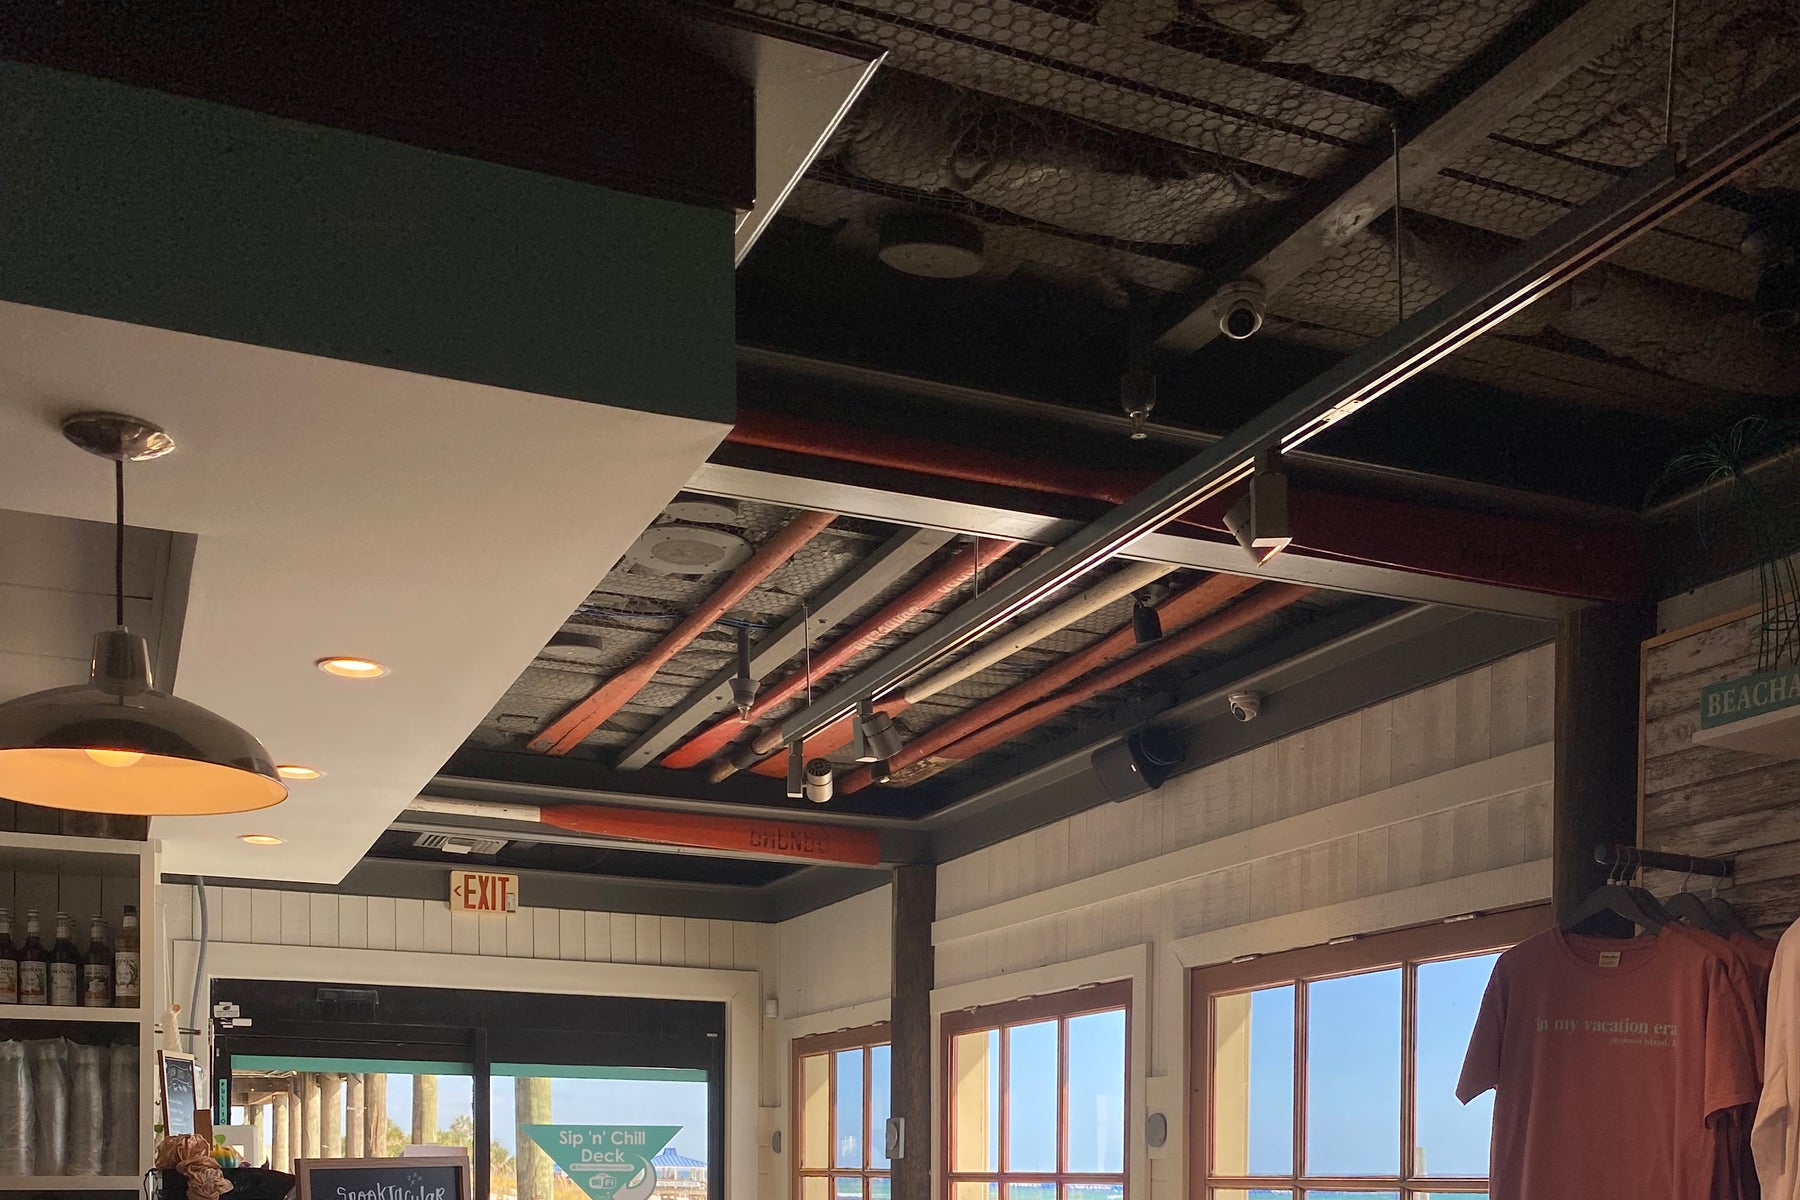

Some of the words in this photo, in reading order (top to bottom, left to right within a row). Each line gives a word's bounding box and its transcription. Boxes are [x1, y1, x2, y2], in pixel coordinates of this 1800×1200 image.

[464, 874, 510, 912] EXIT
[1554, 1018, 1577, 1034] my
[1584, 1018, 1649, 1034] vacation
[1653, 1023, 1678, 1036] era
[559, 1130, 584, 1148] Sip
[611, 1130, 646, 1146] Chill
[581, 1148, 625, 1163] Deck
